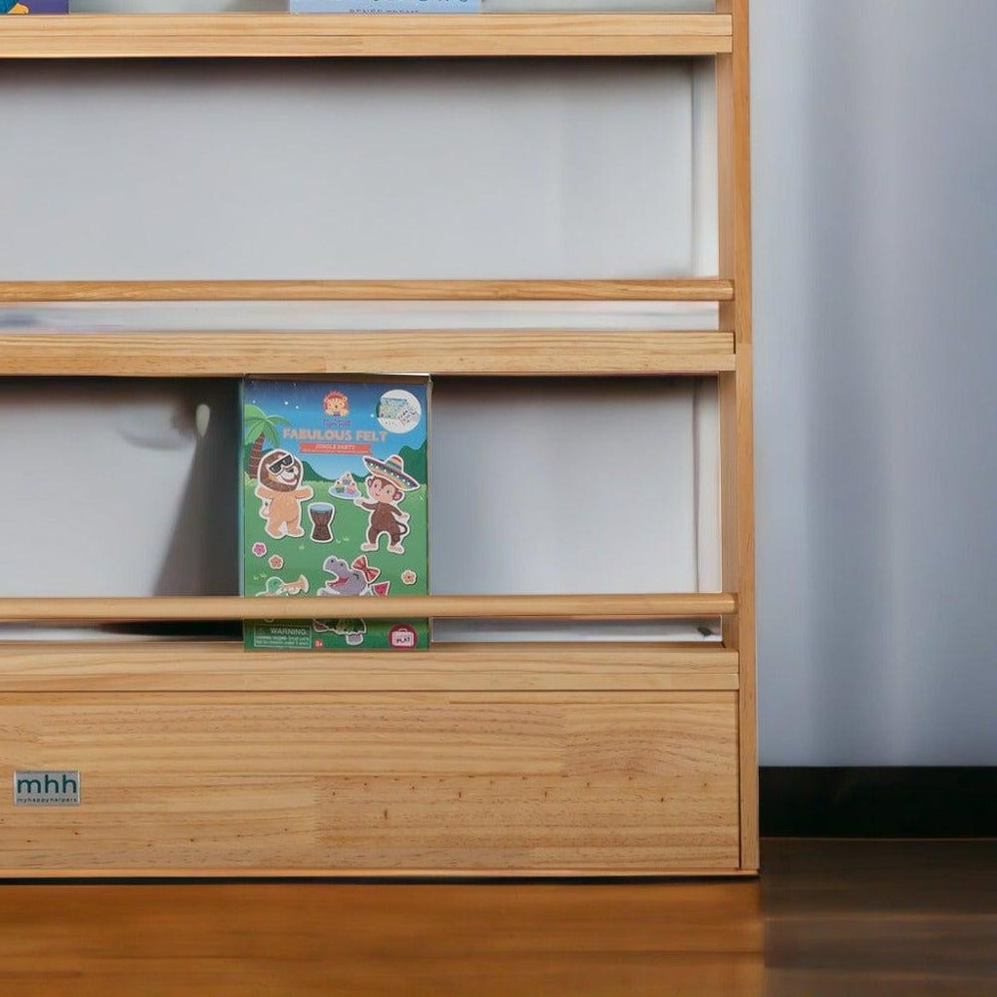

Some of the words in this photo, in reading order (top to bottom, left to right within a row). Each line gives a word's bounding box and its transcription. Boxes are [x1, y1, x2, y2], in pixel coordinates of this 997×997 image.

[282, 428, 352, 442] FABULOUS
[356, 430, 388, 442] FELT
[17, 774, 77, 794] mhh
